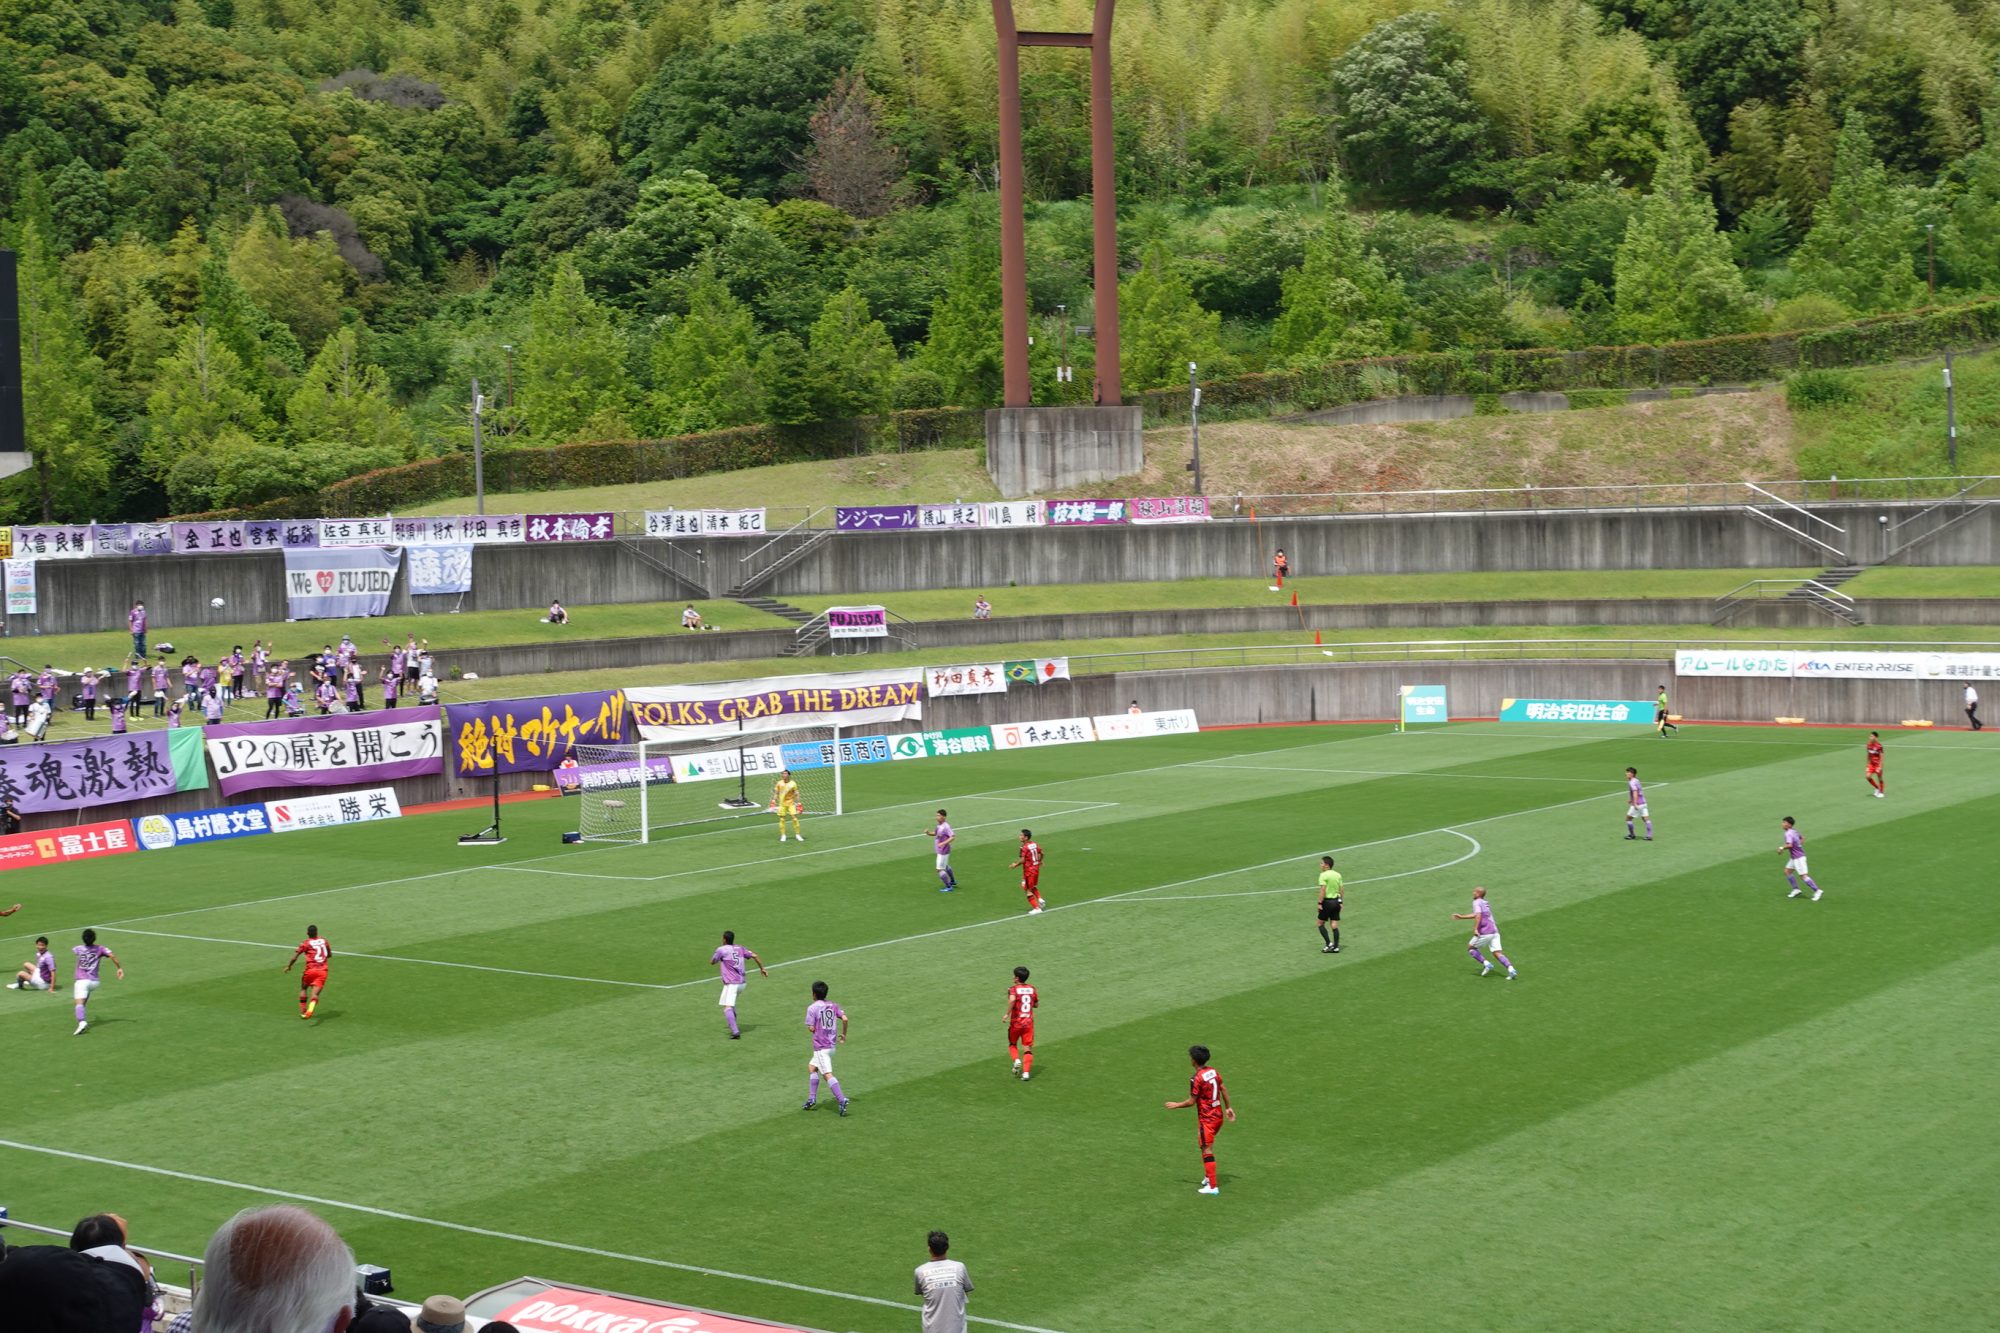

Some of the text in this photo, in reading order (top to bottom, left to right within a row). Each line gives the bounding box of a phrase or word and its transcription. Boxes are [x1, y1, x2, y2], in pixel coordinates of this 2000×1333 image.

[837, 509, 917, 528] シジマール
[290, 572, 312, 594] We
[828, 612, 882, 626] FUJIEDA
[631, 682, 919, 726] FOLKS, GRAB THE DREAM
[1525, 702, 1630, 722] 明治安田生命
[219, 723, 438, 774] J2の扉を開こう
[58, 828, 129, 856] 富士屋
[1021, 994, 1031, 1013] 8
